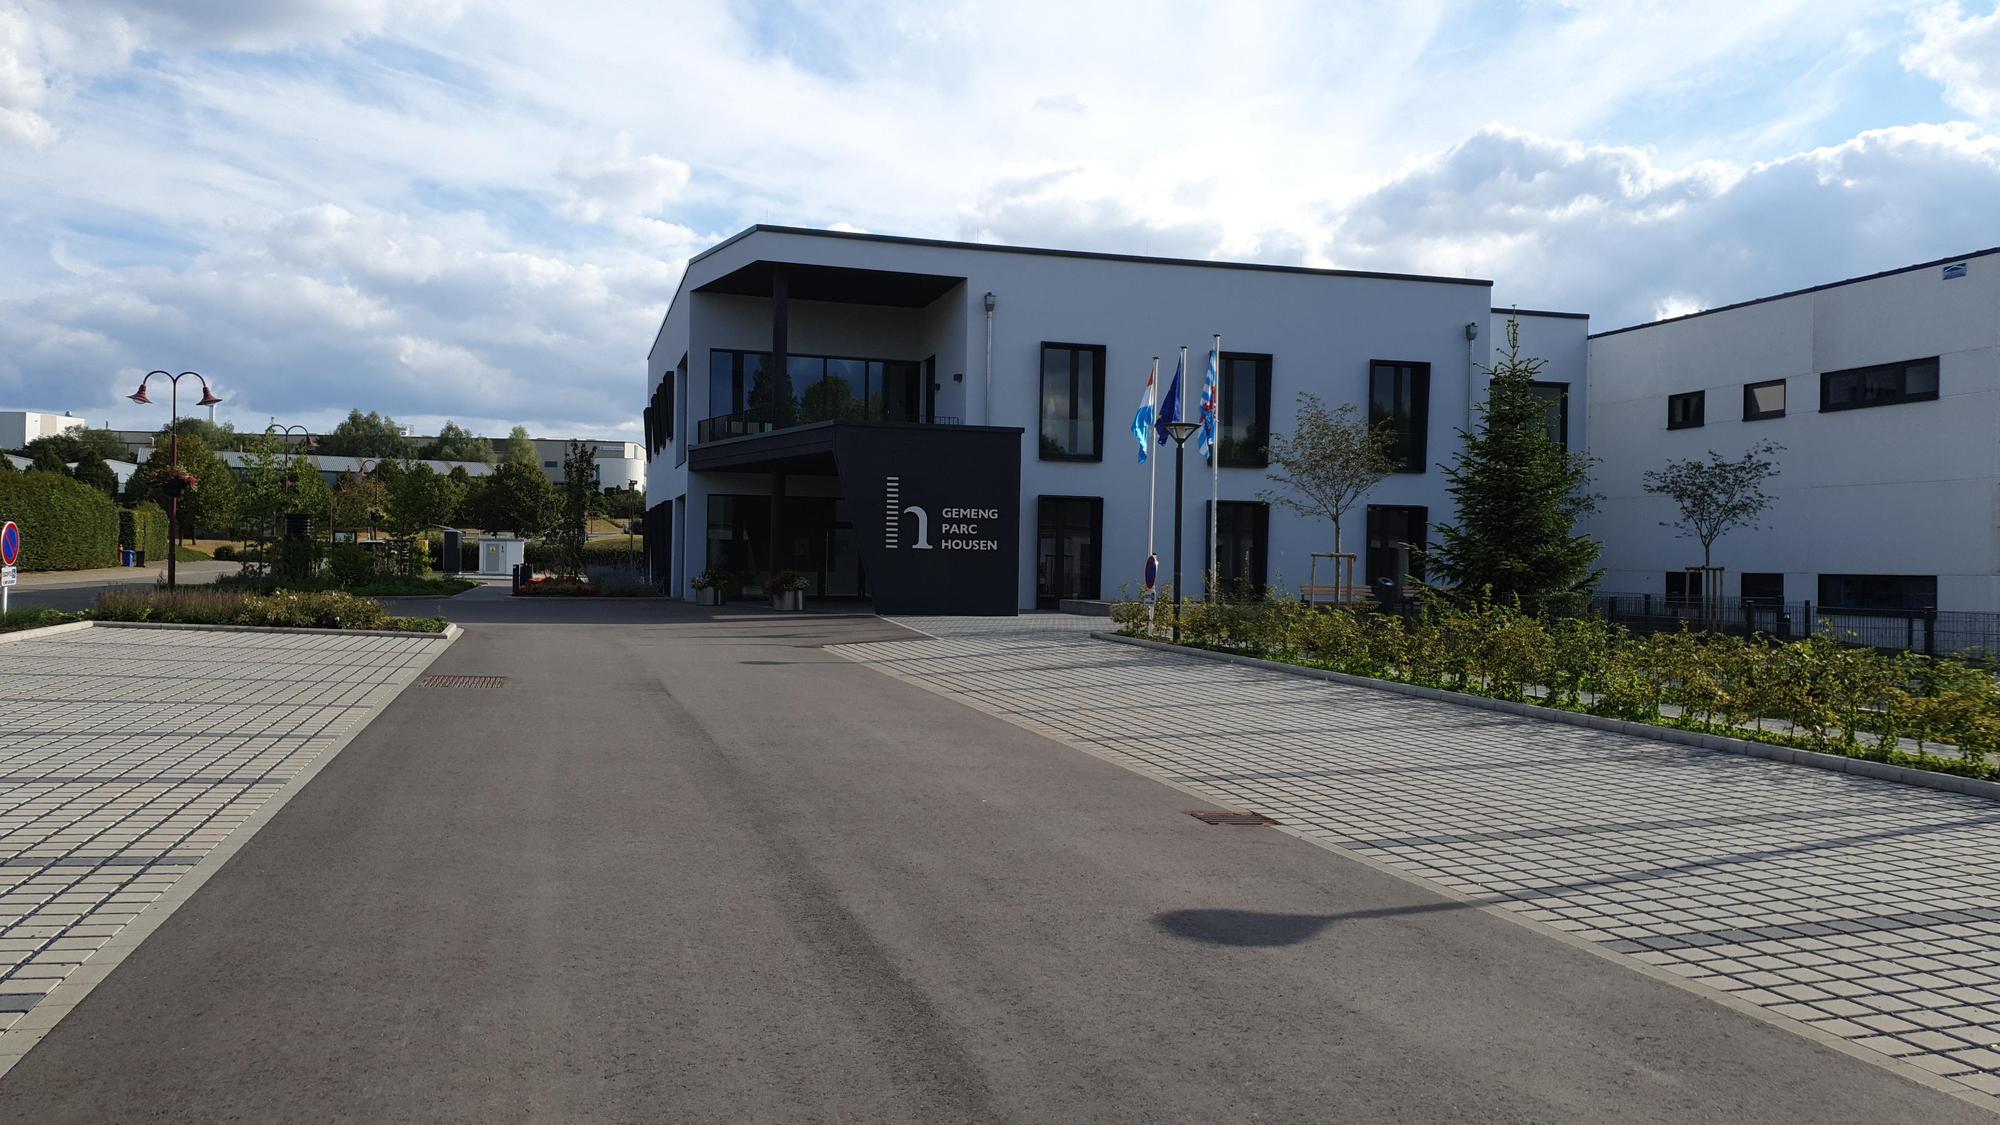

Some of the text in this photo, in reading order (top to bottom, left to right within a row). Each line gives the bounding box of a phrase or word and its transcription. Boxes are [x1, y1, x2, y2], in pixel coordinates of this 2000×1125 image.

[942, 508, 998, 519] GEMENG
[941, 523, 978, 534] PARC
[941, 539, 998, 550] HOUSEN
